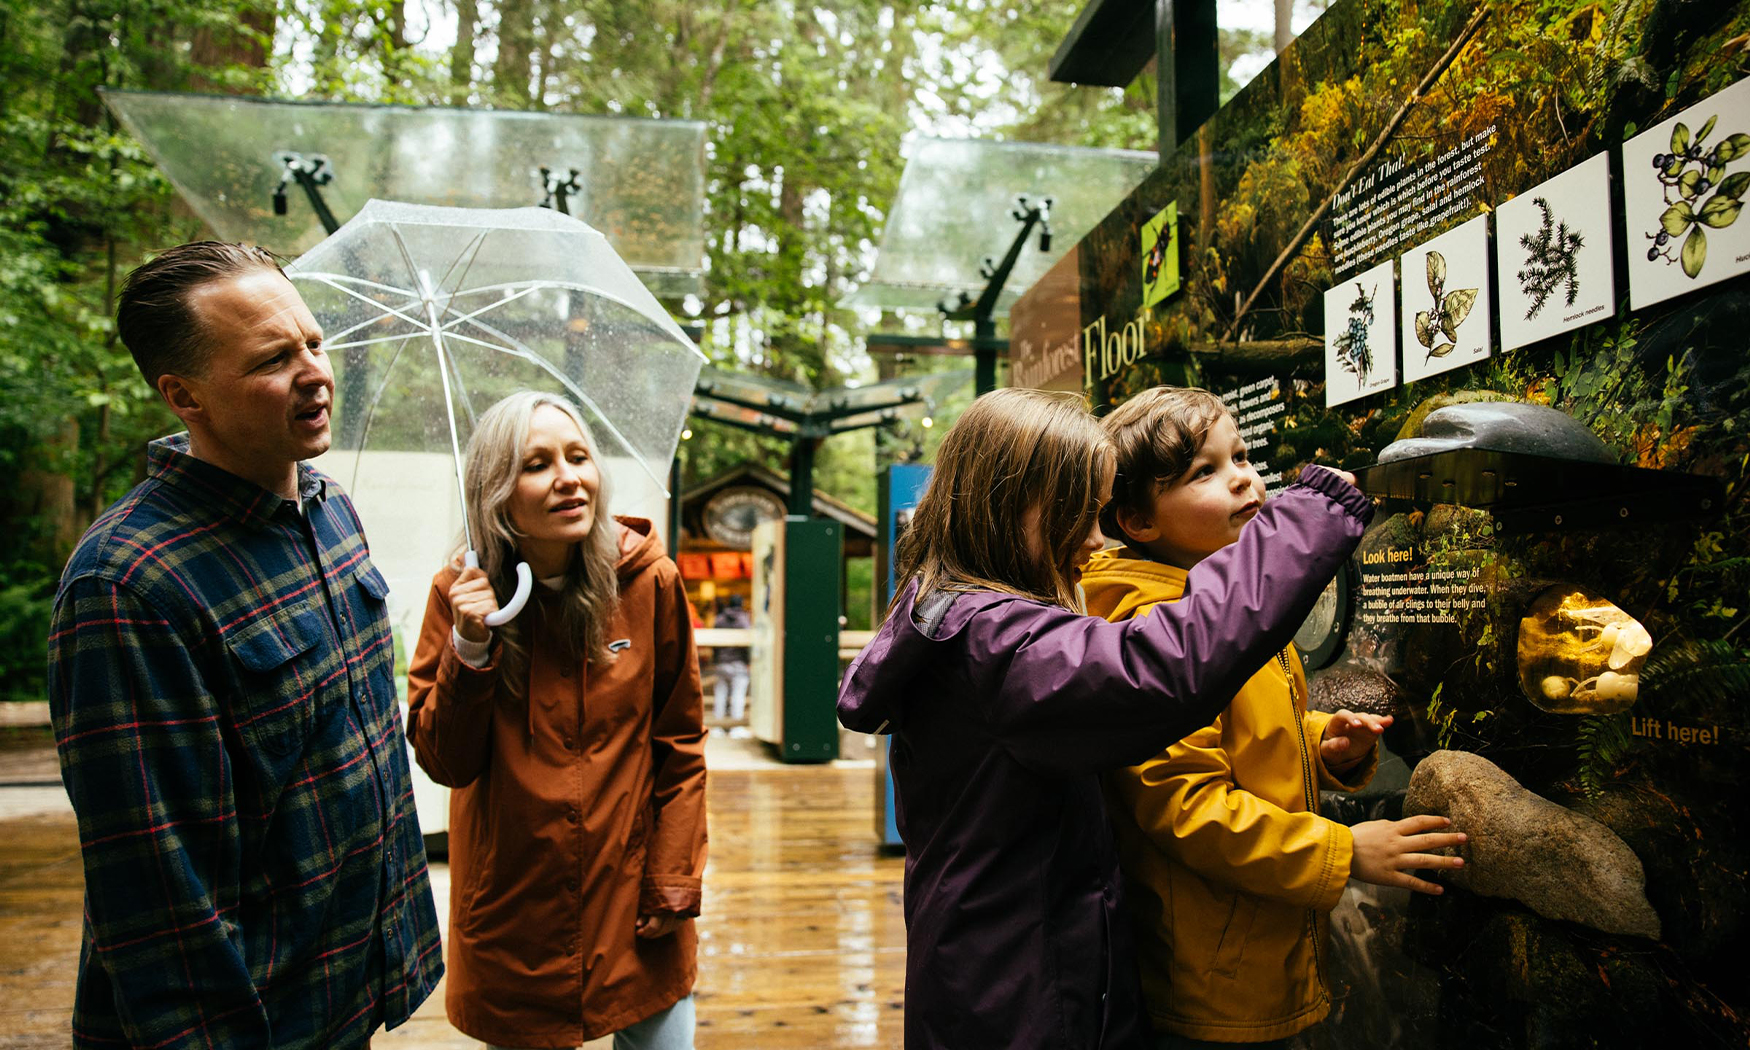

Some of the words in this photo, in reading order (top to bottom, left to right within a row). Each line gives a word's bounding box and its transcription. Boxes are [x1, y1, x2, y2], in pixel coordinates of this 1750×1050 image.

[1332, 184, 1356, 210] Don't
[1358, 172, 1375, 194] Eat
[1378, 152, 1406, 181] That!
[1333, 212, 1348, 227] There
[1348, 207, 1358, 218] are
[1358, 200, 1370, 212] lots
[1370, 194, 1376, 204] of
[1378, 184, 1396, 200] edible
[1396, 172, 1416, 190] plants
[1417, 168, 1424, 178] in
[1425, 160, 1436, 173] the
[1438, 146, 1460, 165] forest,
[1462, 136, 1474, 151] but
[1476, 124, 1496, 142] make
[1334, 228, 1346, 239] sure
[1346, 222, 1356, 234] you
[1356, 212, 1372, 226] know
[1372, 200, 1390, 217] which
[1390, 196, 1396, 206] is
[1397, 184, 1416, 202] which
[1417, 173, 1438, 191] before
[1440, 166, 1452, 180] you
[1452, 153, 1472, 172] taste
[1473, 142, 1491, 159] test.
[1334, 236, 1349, 251] Some
[1350, 227, 1367, 242] edible
[1367, 217, 1386, 234] plants
[1386, 210, 1398, 223] you
[1398, 202, 1412, 216] may
[1412, 194, 1425, 208] find
[1426, 189, 1433, 199] in
[1434, 182, 1446, 195] the
[1447, 161, 1482, 188] rainforest
[1334, 252, 1343, 263] are
[1378, 222, 1400, 239] Oregon
[1400, 212, 1420, 229] grape,
[1422, 201, 1438, 216] salal
[1439, 192, 1452, 206] and
[1454, 175, 1485, 198] hemlock
[1334, 258, 1356, 275] needles
[1356, 248, 1374, 266] (these
[1375, 236, 1398, 254] needles
[1400, 226, 1416, 242] taste
[1416, 220, 1429, 232] like
[1430, 197, 1472, 227] grapefruit!).
[1083, 309, 1150, 389] Floor
[1246, 402, 1285, 422] decomposers
[1362, 550, 1386, 565] Look
[1388, 546, 1413, 562] here!
[1362, 574, 1380, 584] Water
[1381, 572, 1408, 582] boatmen
[1408, 572, 1424, 581] have
[1431, 570, 1454, 582] unique
[1456, 570, 1470, 581] way
[1472, 567, 1480, 578] of
[1362, 586, 1391, 597] breathing
[1392, 584, 1428, 596] underwater.
[1430, 584, 1450, 594] When
[1451, 584, 1467, 596] they
[1468, 582, 1486, 594] dive,
[1368, 600, 1388, 609] bubble
[1388, 600, 1396, 609] of
[1396, 600, 1404, 609] air
[1406, 599, 1425, 611] clings
[1426, 600, 1434, 609] to
[1435, 599, 1452, 609] their
[1452, 598, 1470, 610] belly
[1472, 598, 1486, 608] and
[1362, 614, 1376, 625] they
[1376, 614, 1400, 623] breathe
[1400, 614, 1416, 623] from
[1416, 614, 1430, 623] that
[1432, 614, 1457, 624] bubble.
[1632, 716, 1662, 739] Lift
[1667, 720, 1719, 745] here!
